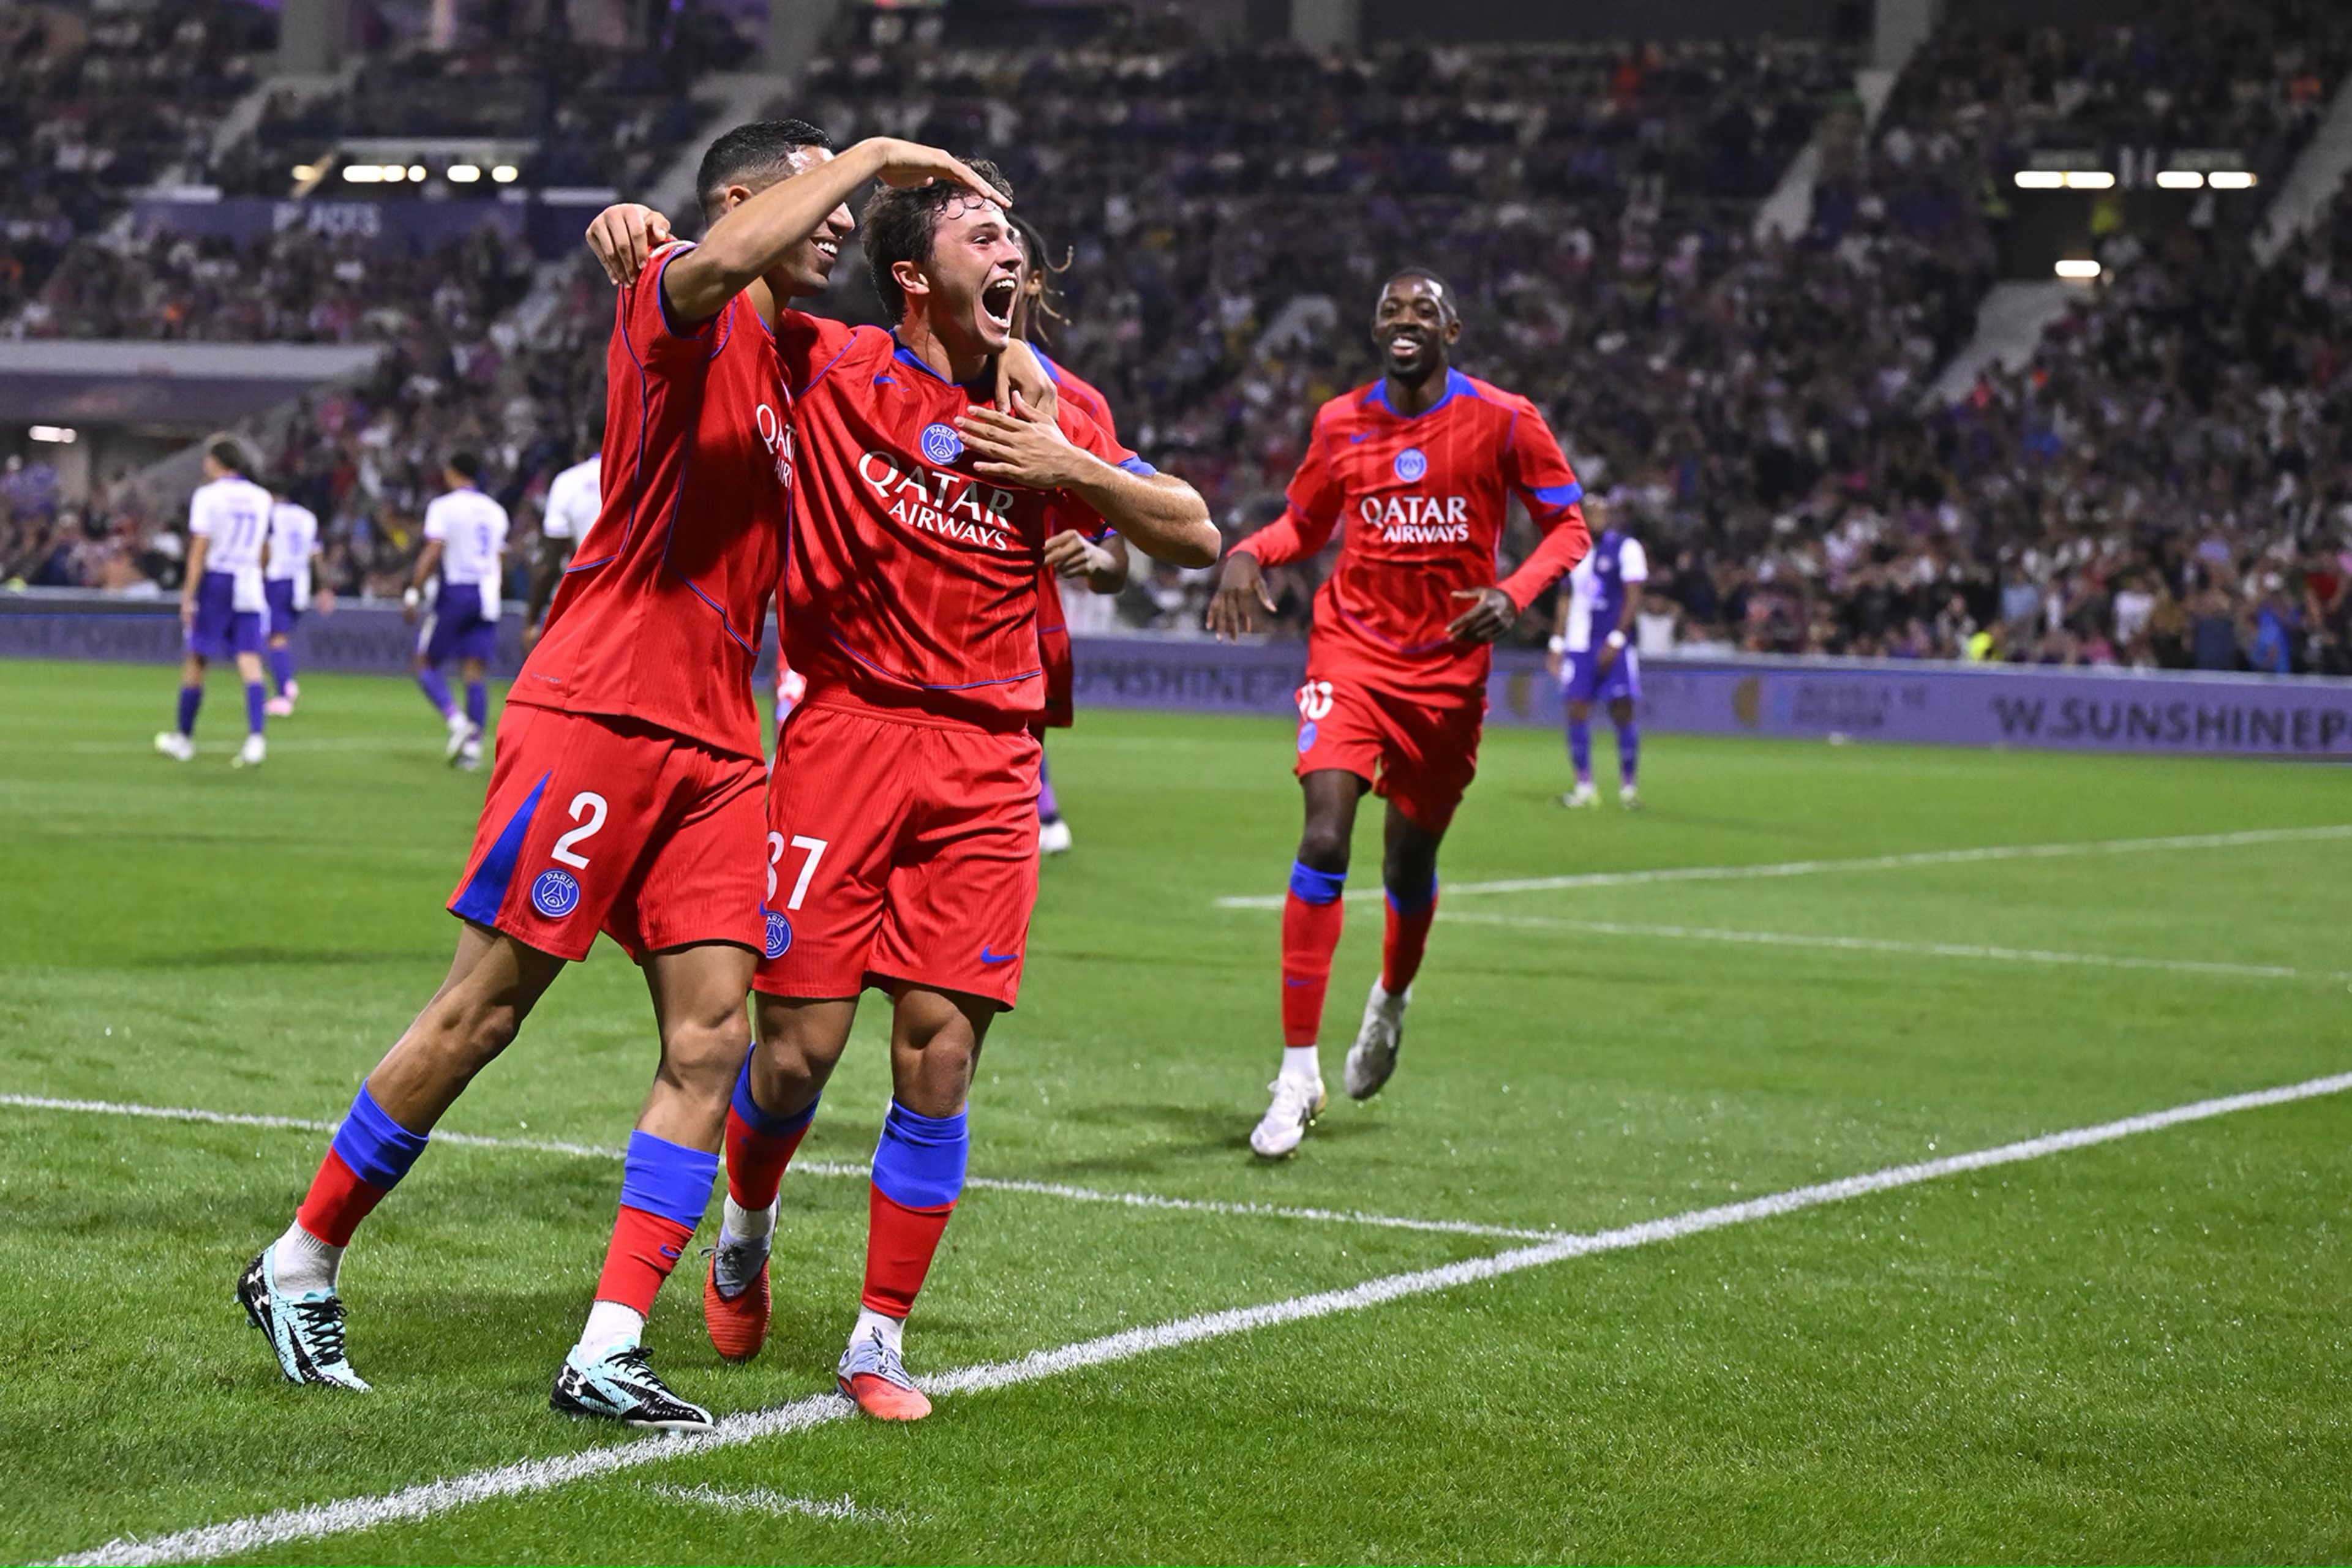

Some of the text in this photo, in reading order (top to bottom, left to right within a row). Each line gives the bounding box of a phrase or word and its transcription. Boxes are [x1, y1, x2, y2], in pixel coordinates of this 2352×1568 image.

[756, 403, 797, 462] QAT
[930, 427, 956, 441] PARIS
[859, 451, 1013, 529] QATAR
[228, 511, 257, 549] 77
[888, 499, 1007, 550] AIRWAYS
[1360, 496, 1468, 529] QATAR
[1382, 523, 1469, 543] AIRWAYS
[550, 791, 608, 870] 2
[546, 872, 575, 890] PARIS
[767, 915, 786, 928] ARIS
